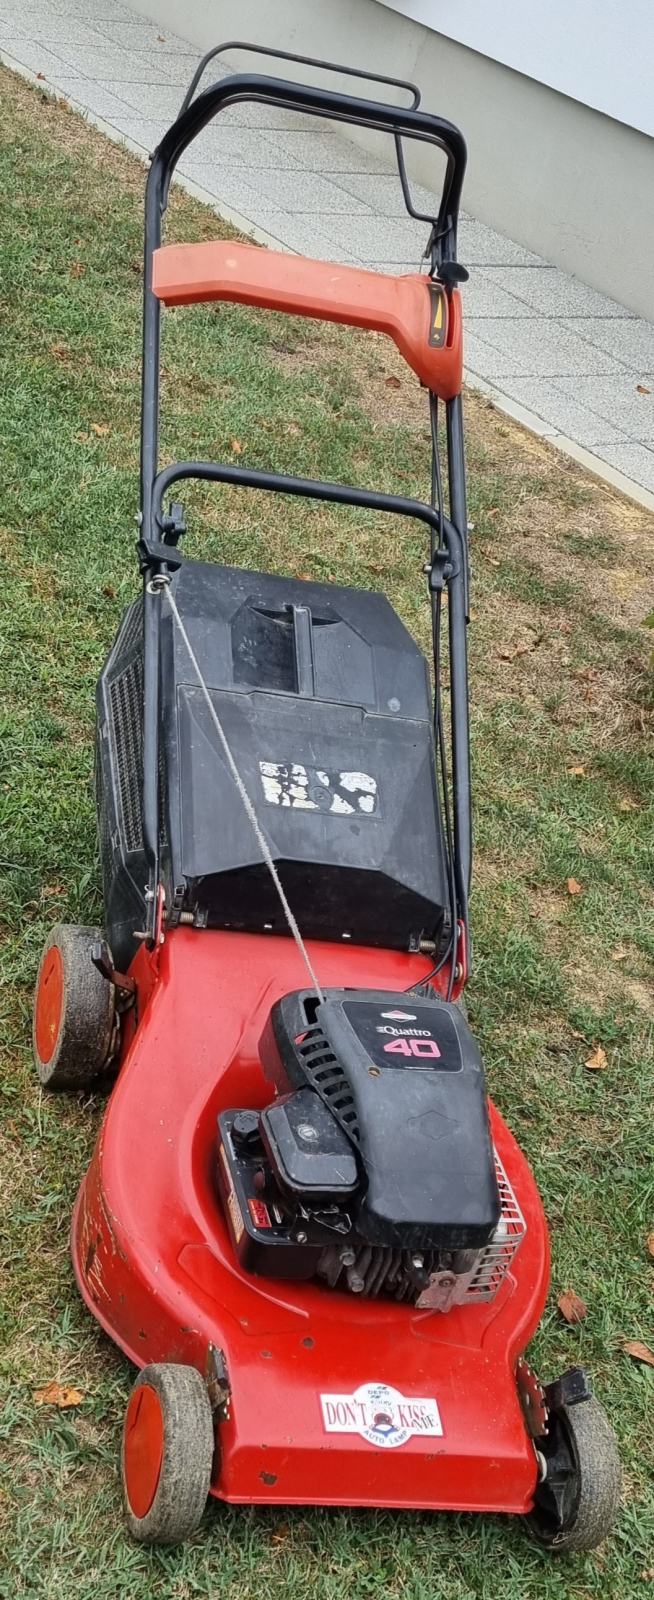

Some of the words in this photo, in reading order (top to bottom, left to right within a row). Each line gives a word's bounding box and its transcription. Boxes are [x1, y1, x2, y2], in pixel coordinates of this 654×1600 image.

[383, 1025, 432, 1037] Quattro
[383, 1038, 442, 1058] 40
[325, 1399, 368, 1427] DON'T
[364, 1430, 386, 1444] AUTO
[389, 1430, 408, 1445] LAMP
